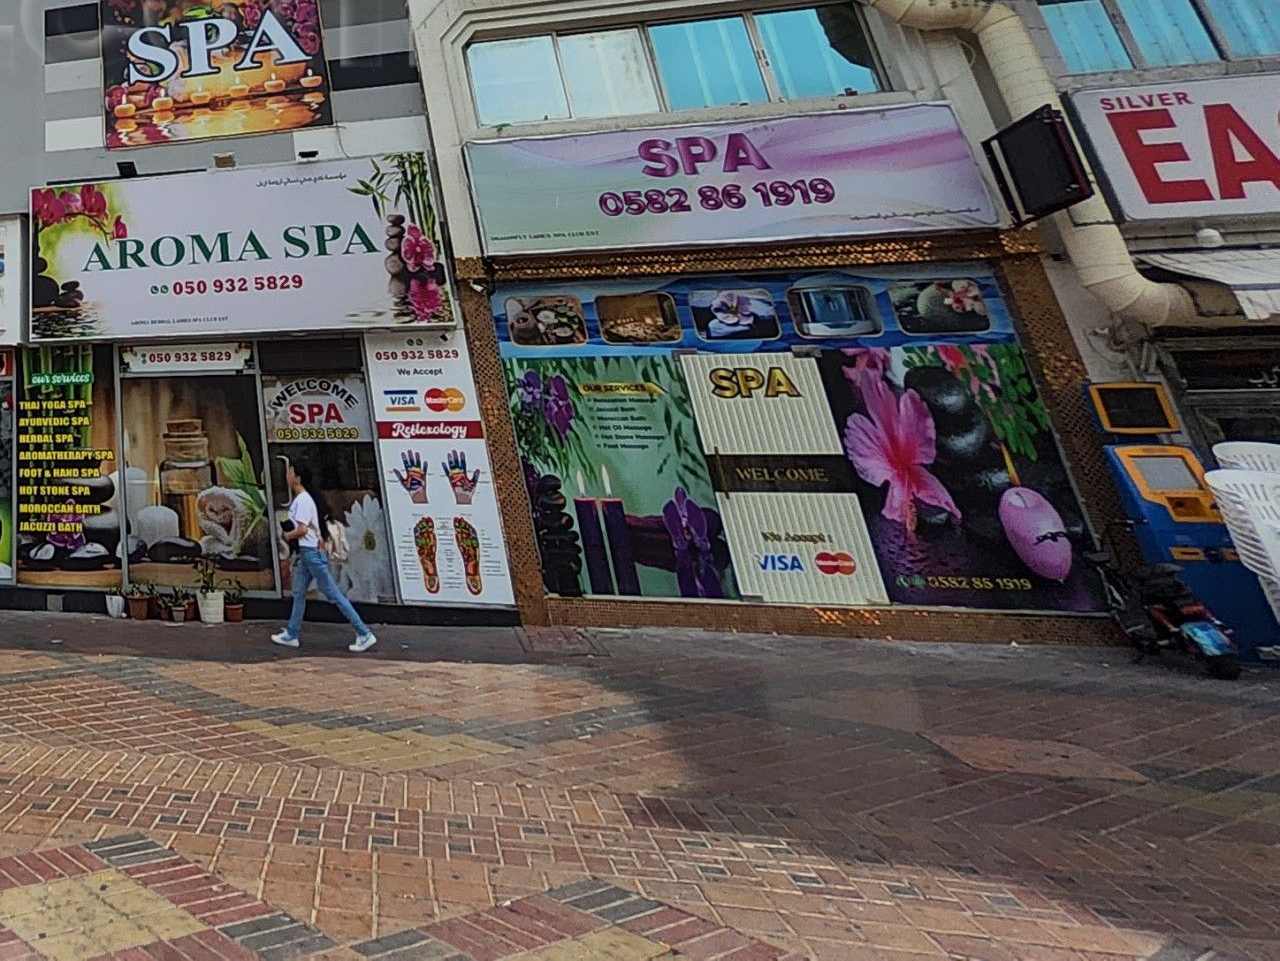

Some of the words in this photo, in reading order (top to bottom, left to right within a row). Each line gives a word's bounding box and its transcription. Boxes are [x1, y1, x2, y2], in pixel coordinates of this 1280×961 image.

[126, 8, 313, 84] SPA
[1099, 91, 1194, 113] SILVER
[637, 132, 772, 179] SPA
[1105, 102, 1280, 205] EA
[598, 188, 692, 218] 0582
[698, 184, 747, 211] 86
[750, 177, 836, 207] 1919
[81, 229, 272, 272] AROMA
[283, 221, 382, 260] SPA
[172, 281, 208, 296] 050
[213, 277, 249, 293] 932
[254, 274, 304, 291] 5829
[148, 352, 171, 363] 050
[174, 351, 198, 362] 932
[200, 350, 232, 361] 5829
[375, 350, 399, 361] 050
[401, 349, 425, 360] 932
[427, 349, 459, 359] 5829
[31, 374, 51, 384] our
[51, 372, 91, 384] services
[397, 368, 411, 376] We
[412, 368, 443, 377] Accept
[603, 383, 647, 392] SERVICES
[708, 365, 804, 399] SPA
[271, 378, 359, 410] WELCOME
[19, 401, 41, 410] THAI
[42, 400, 66, 410] YOGA
[67, 400, 87, 409] SPA
[390, 396, 416, 406] VISA
[289, 402, 345, 425] SPA
[19, 417, 70, 427] AYURVEDIC
[71, 417, 91, 426] SPA
[276, 429, 301, 440] 050
[302, 428, 326, 440] 932
[328, 428, 359, 439] 5829
[391, 421, 468, 439] Reflexology
[19, 435, 54, 444] HERBAL
[55, 434, 74, 443] SPA
[19, 451, 94, 461] AROMATHERAPY
[95, 451, 114, 460] SPA
[19, 469, 43, 478] FOOT
[44, 470, 51, 478] &
[53, 469, 80, 478] HAND
[81, 469, 100, 478] SPA
[735, 467, 827, 483] WELCOME
[19, 486, 38, 496] HOT
[40, 486, 70, 496] STONE
[71, 486, 91, 496] SPA
[19, 504, 73, 514] MOROCCAN
[75, 504, 101, 514] BATH
[19, 521, 57, 532] JACUZZI
[58, 522, 83, 533] BATH
[755, 553, 805, 572] VISA
